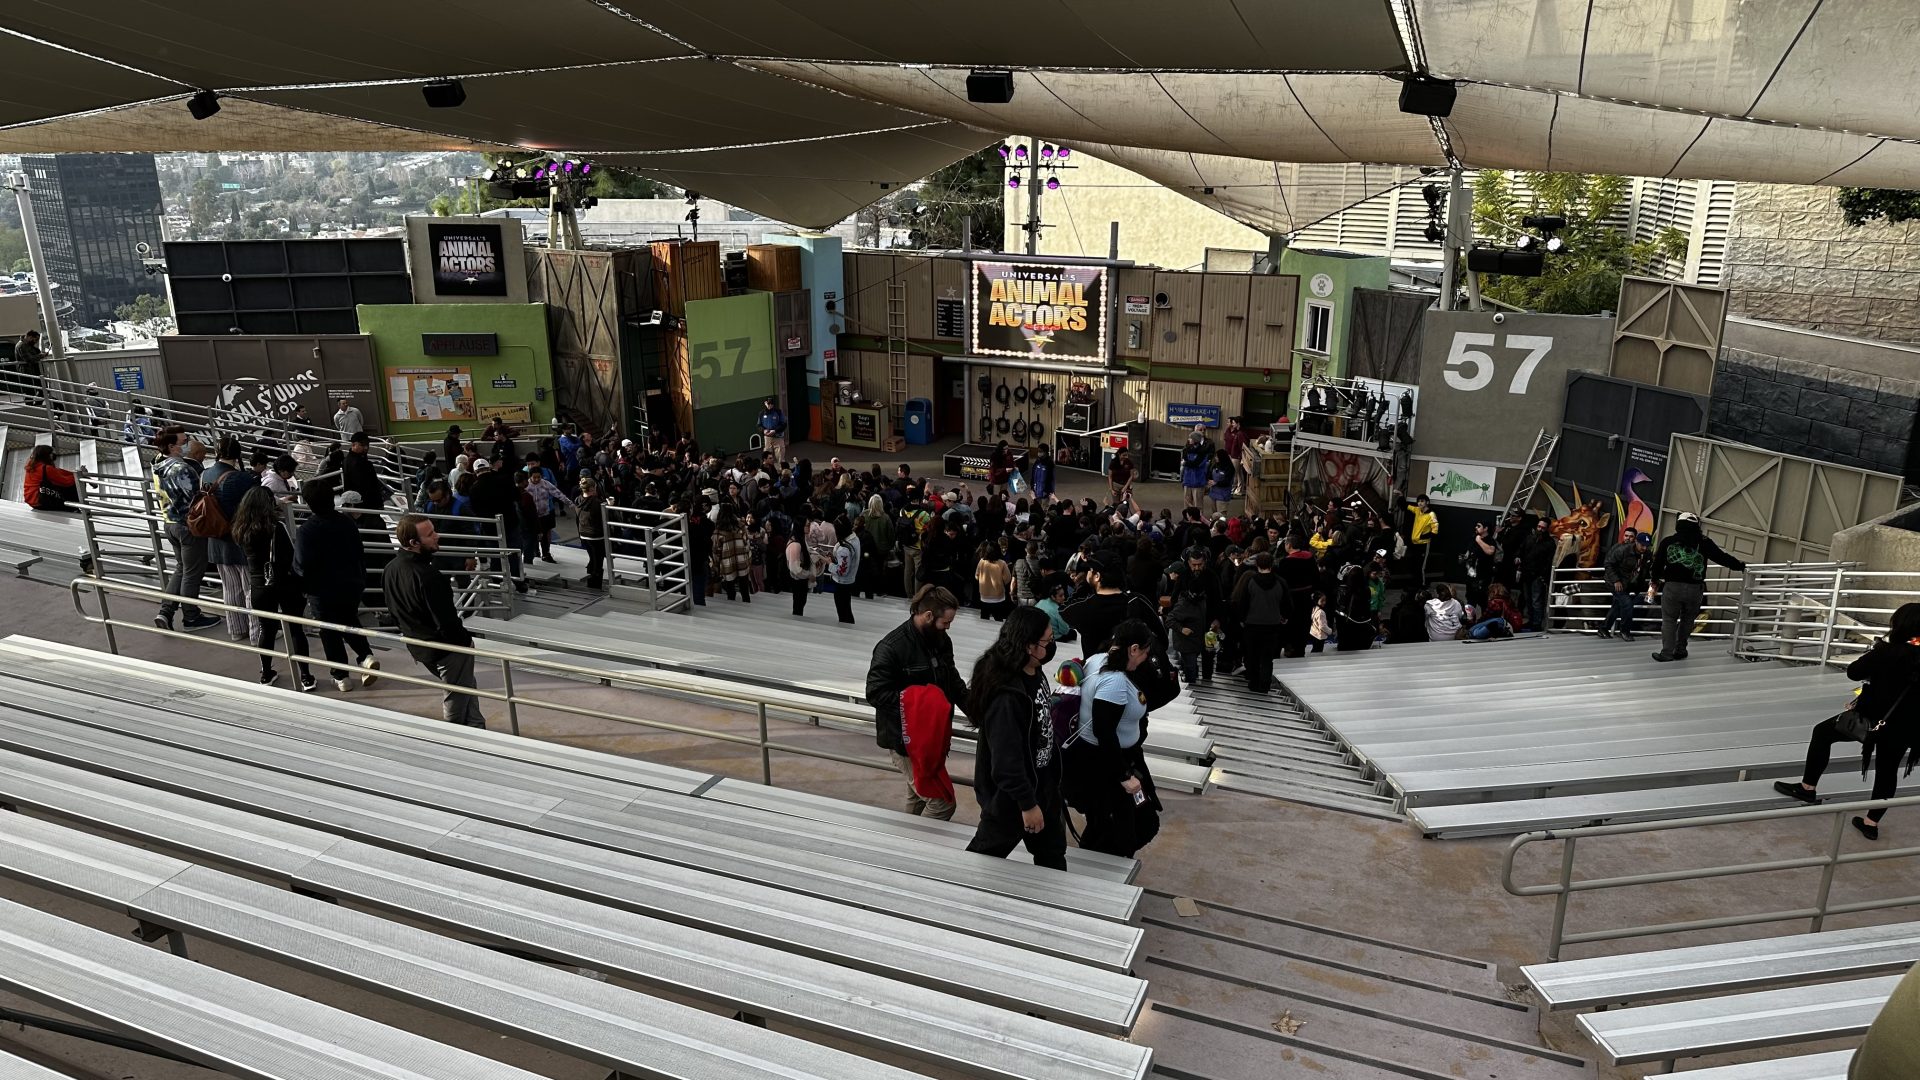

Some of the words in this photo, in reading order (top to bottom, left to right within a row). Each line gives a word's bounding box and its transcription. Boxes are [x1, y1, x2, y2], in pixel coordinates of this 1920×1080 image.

[439, 241, 495, 257] ANIMAL
[440, 256, 496, 273] ACTORS
[1001, 271, 1077, 281] UNIVERSAL'S
[990, 279, 1089, 307] ANIMAL
[989, 302, 1088, 332] ACTORS
[431, 340, 491, 351] APPLAUSE
[692, 337, 750, 379] 57
[1443, 331, 1554, 395] 57
